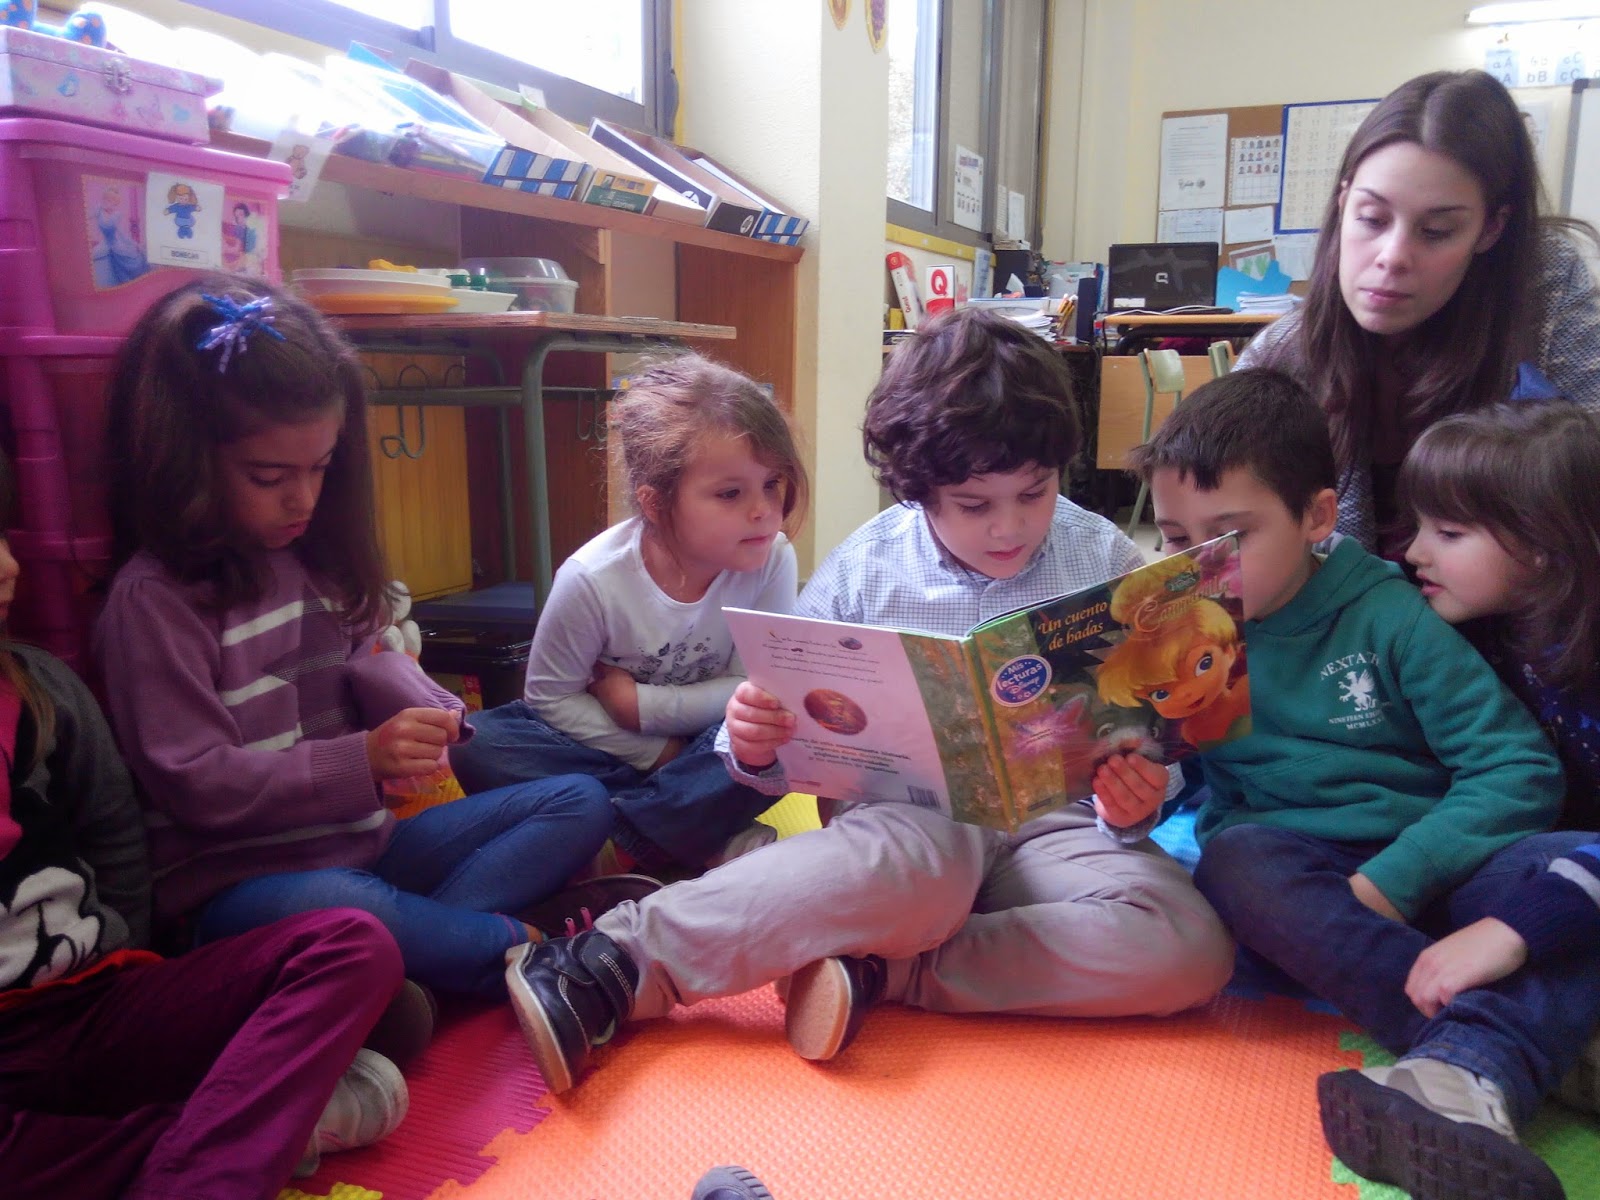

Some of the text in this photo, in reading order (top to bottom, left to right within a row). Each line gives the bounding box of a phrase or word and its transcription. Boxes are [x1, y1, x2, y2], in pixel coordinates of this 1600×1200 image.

[930, 269, 948, 296] Q
[1038, 601, 1108, 635] Un cuento
[1048, 632, 1064, 651] de
[995, 662, 1043, 691] lecturas
[1007, 661, 1025, 675] Mis
